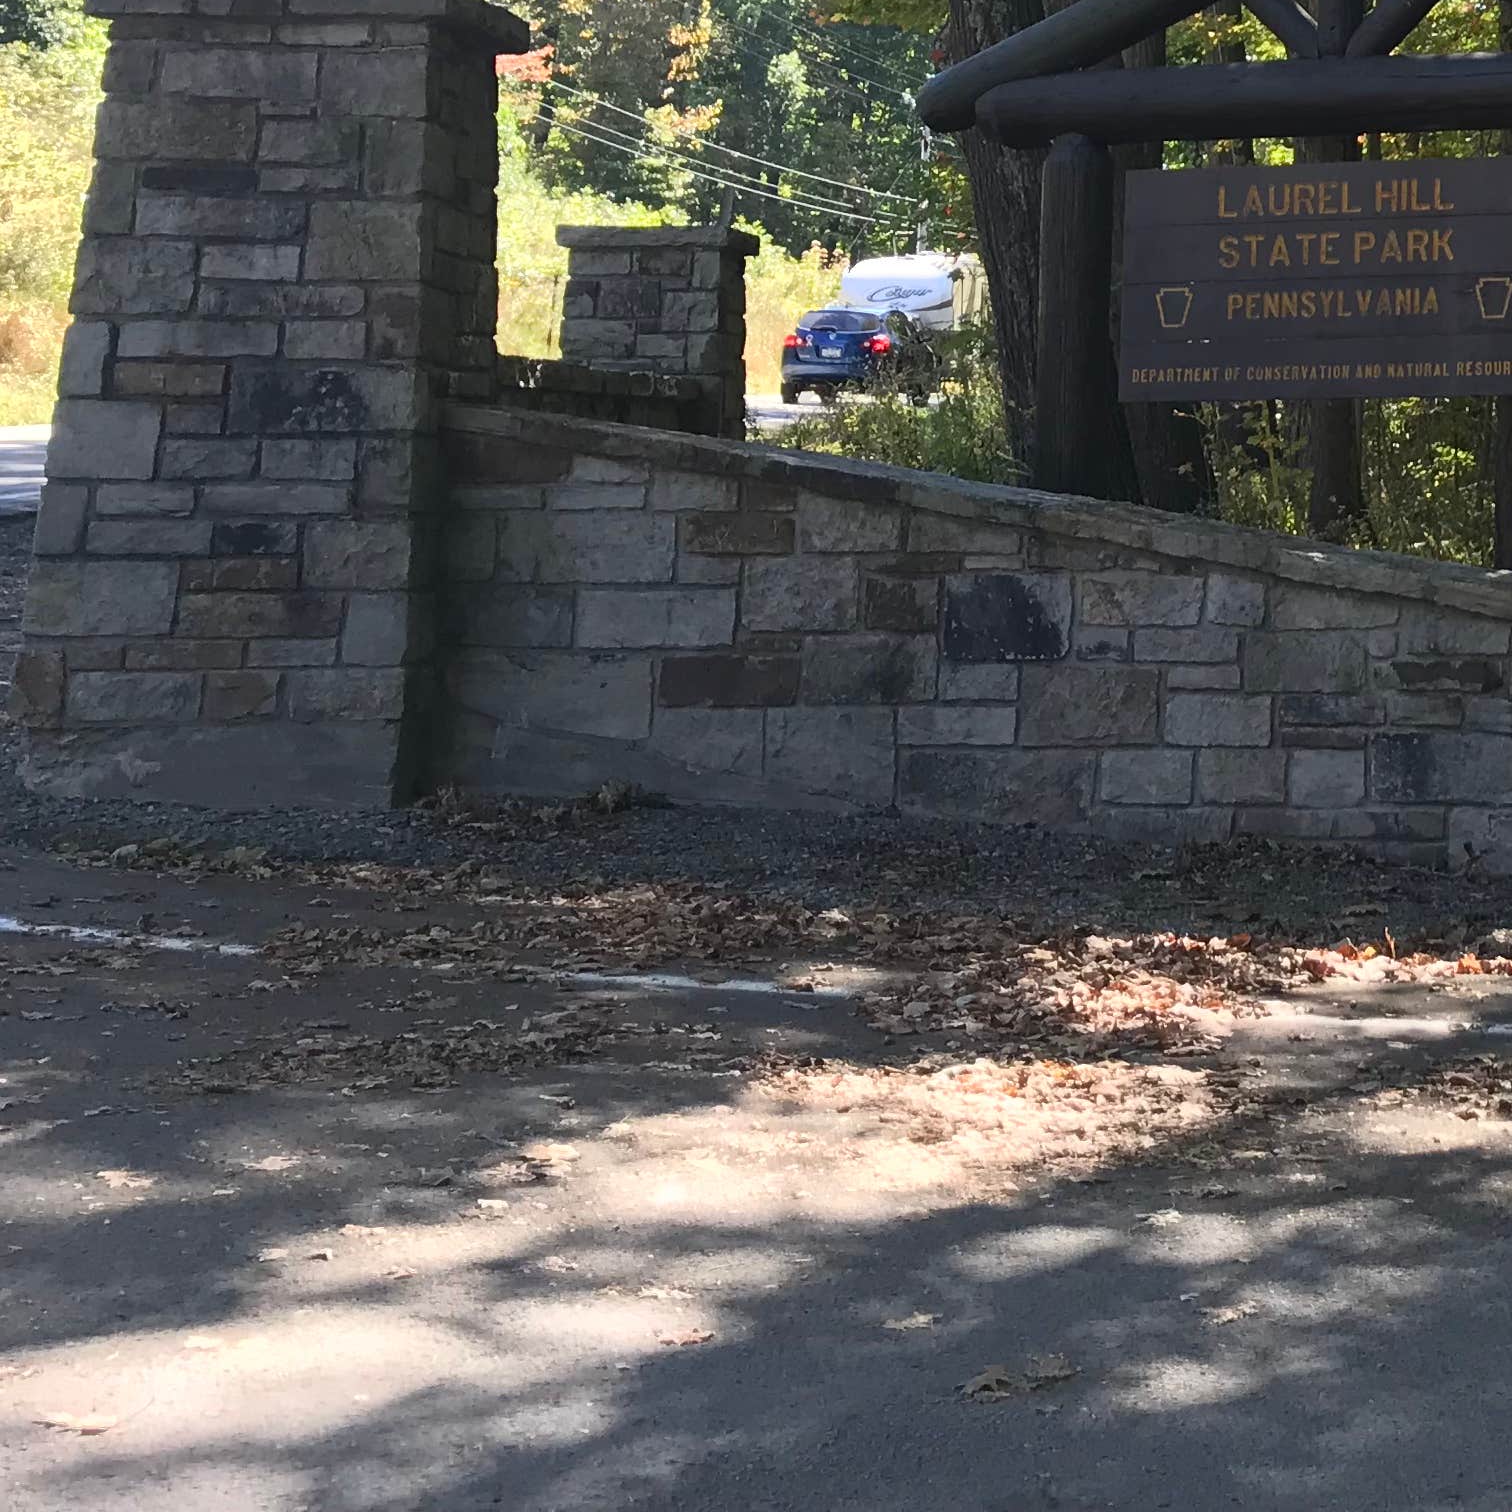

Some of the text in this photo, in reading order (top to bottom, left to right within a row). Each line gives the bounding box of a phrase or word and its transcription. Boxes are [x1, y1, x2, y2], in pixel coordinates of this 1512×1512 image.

[1217, 177, 1455, 219] LAUREL HILL
[1217, 228, 1455, 269] STATE PARK
[1226, 286, 1440, 321] PENNSYLVANIA
[1131, 366, 1219, 384] DEPARTMENT
[1224, 366, 1241, 382] OF
[1246, 364, 1350, 381] CONSERVATION
[1355, 364, 1382, 380] AND
[1386, 361, 1450, 379] NATURAL
